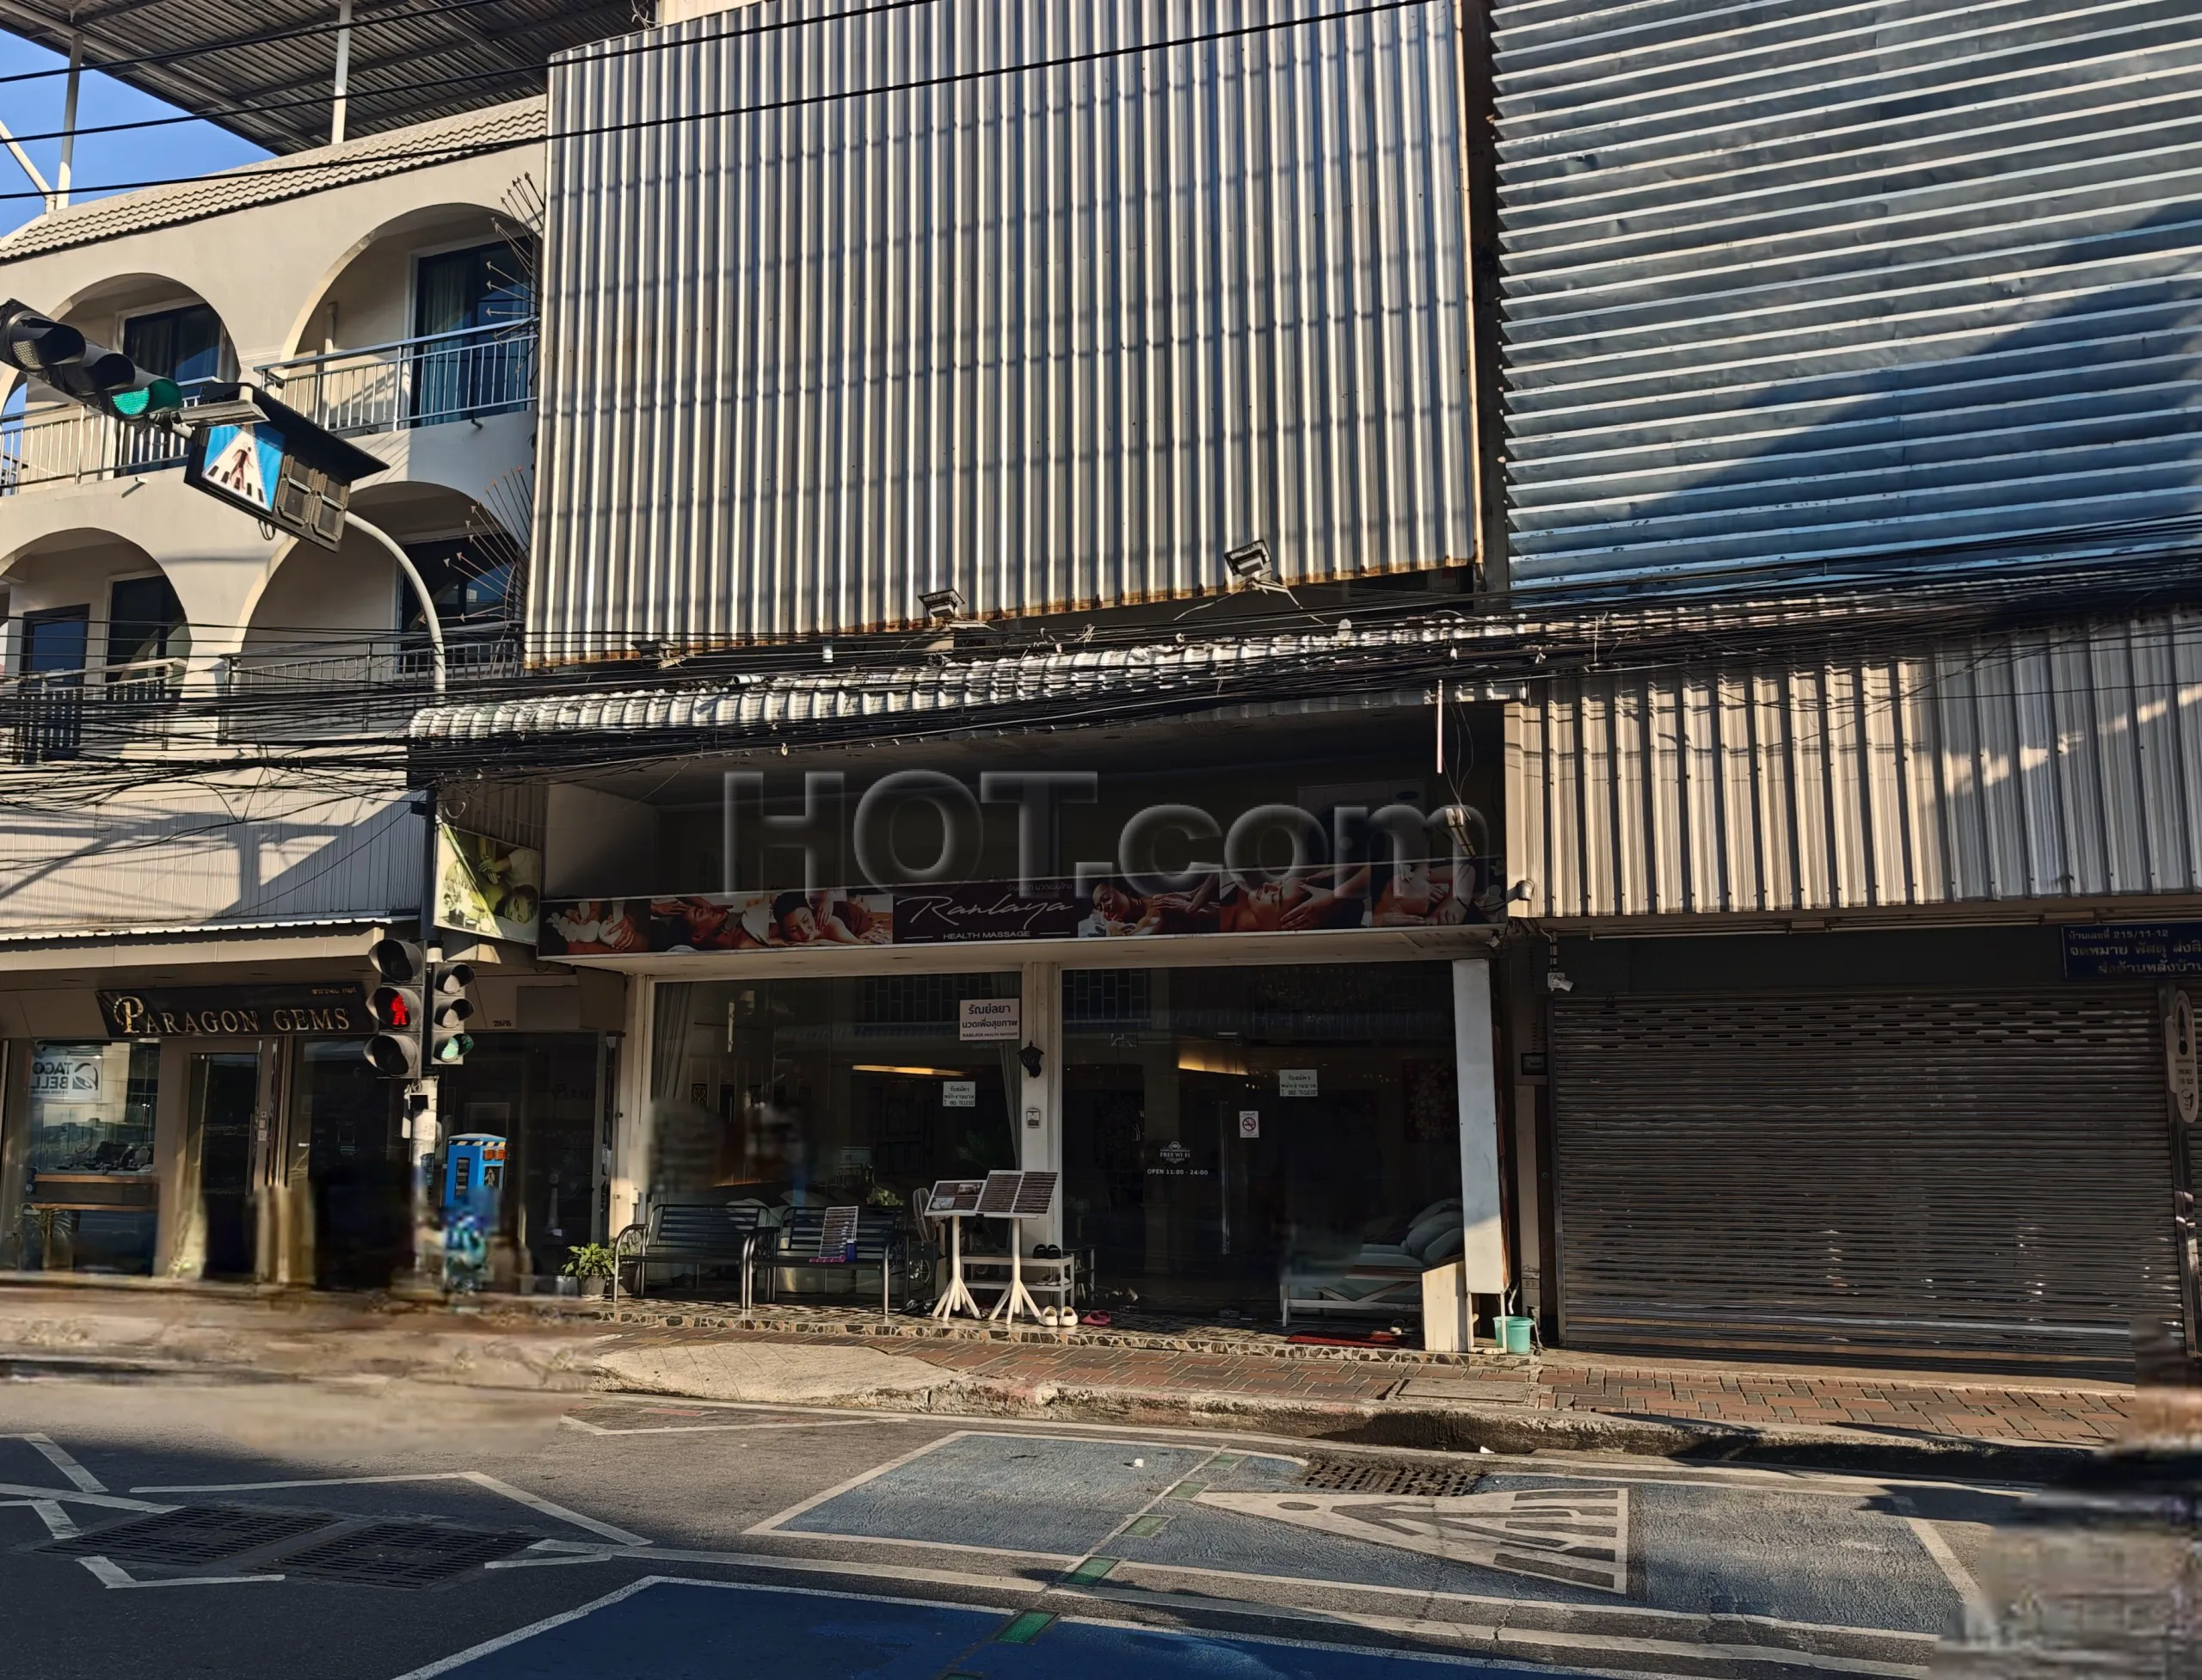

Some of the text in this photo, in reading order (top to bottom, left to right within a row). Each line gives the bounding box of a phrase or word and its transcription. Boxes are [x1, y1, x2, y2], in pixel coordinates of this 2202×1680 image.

[895, 893, 1073, 930] Ranlaya
[943, 930, 1030, 940] HEALTH MASSAGE
[2113, 929, 2169, 939] 215/11-12
[969, 1003, 1011, 1014] รัณย์ลยา
[273, 1006, 351, 1032] GEMS
[962, 1016, 1018, 1030] นวดเพื่อสุขภาพ
